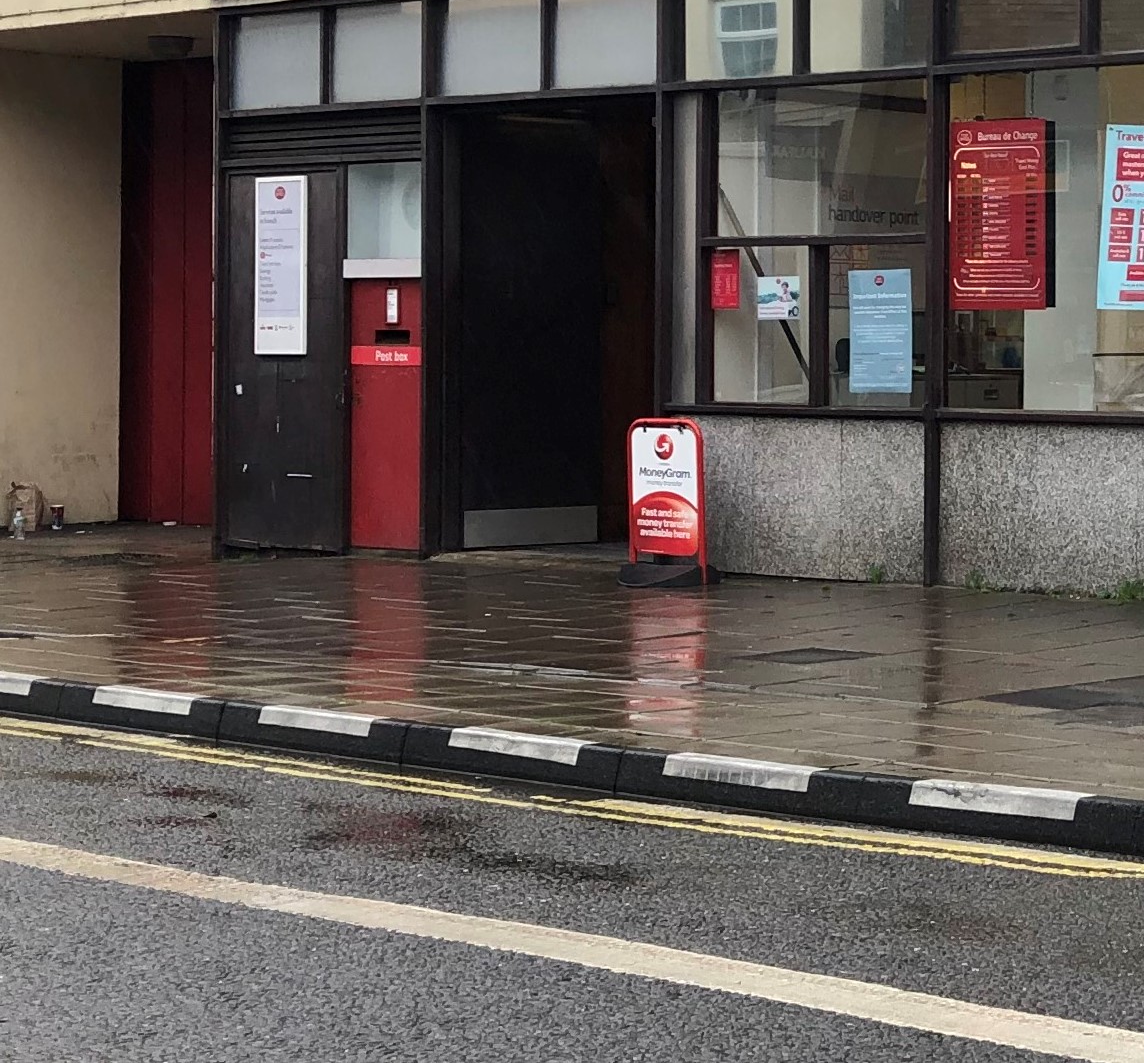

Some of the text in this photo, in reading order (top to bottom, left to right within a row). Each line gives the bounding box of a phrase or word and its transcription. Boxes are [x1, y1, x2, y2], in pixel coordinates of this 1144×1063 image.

[978, 132, 1001, 141] Bureau
[1003, 132, 1011, 141] de
[1013, 131, 1038, 141] Change
[828, 204, 920, 227] handover point
[375, 350, 408, 362] Post box
[638, 467, 691, 479] MoneyGram
[641, 507, 657, 518] Fast
[658, 508, 672, 518] and
[637, 519, 693, 529] money transfer
[640, 528, 691, 540] available here
